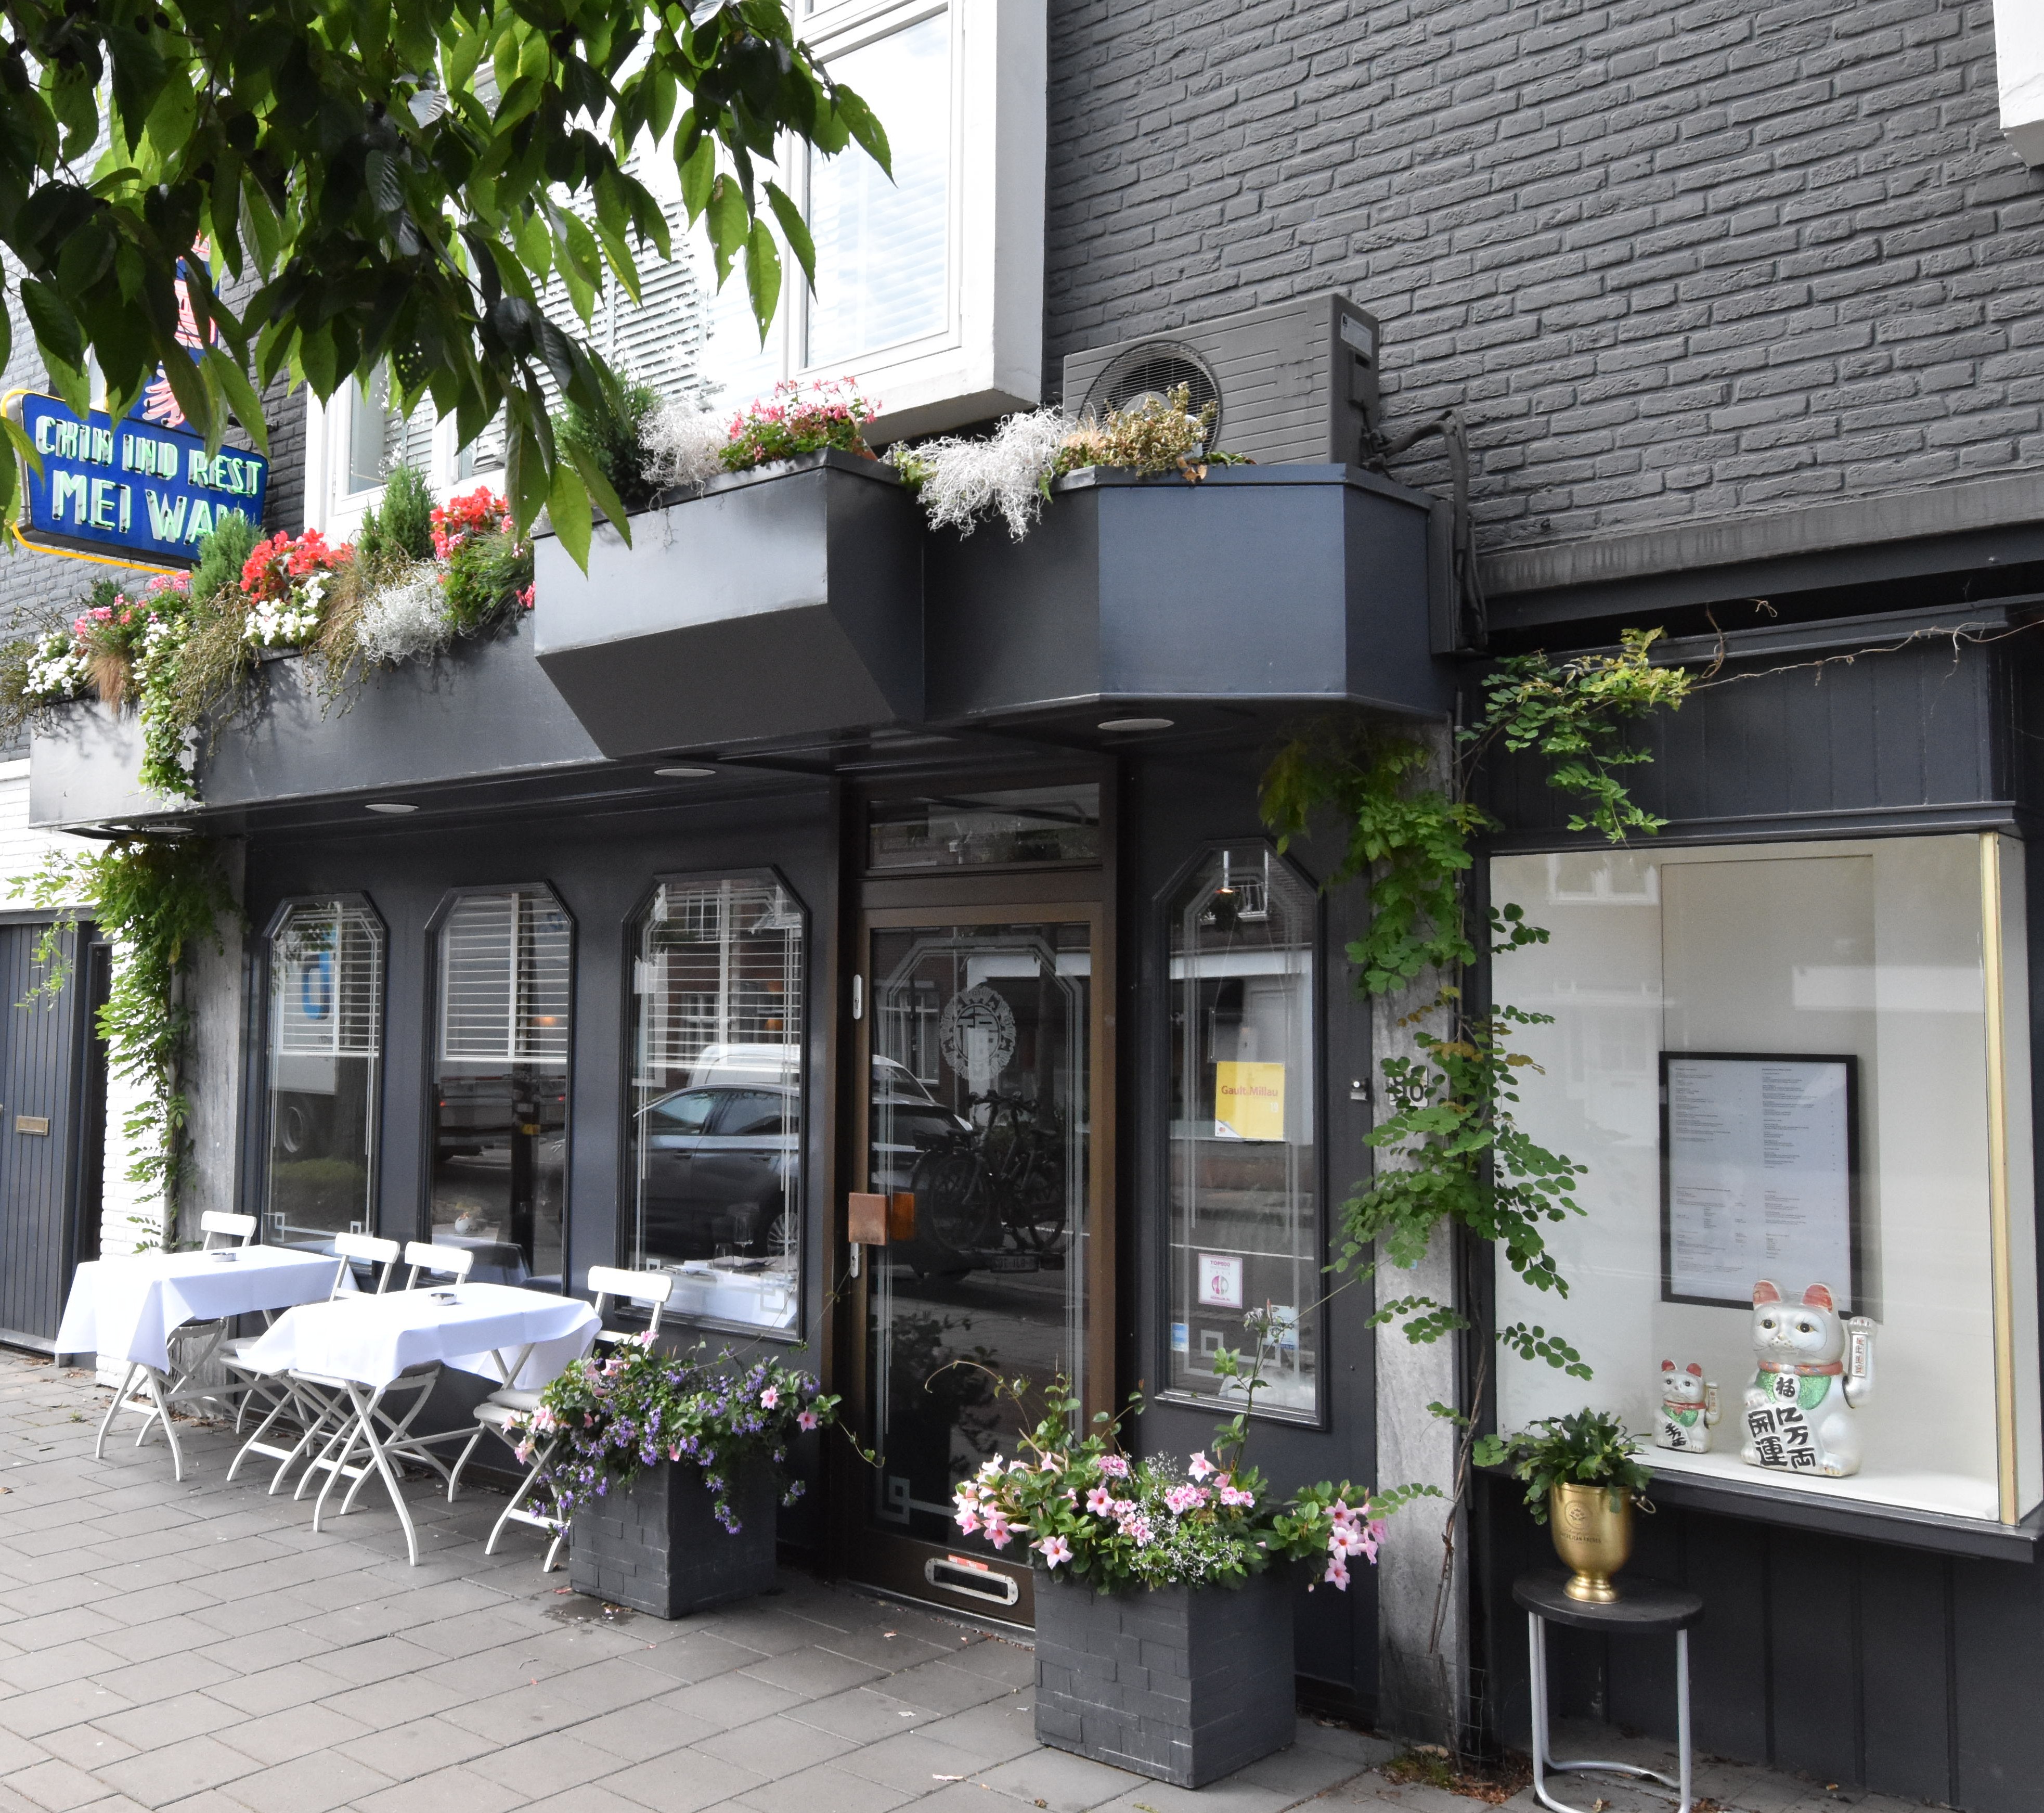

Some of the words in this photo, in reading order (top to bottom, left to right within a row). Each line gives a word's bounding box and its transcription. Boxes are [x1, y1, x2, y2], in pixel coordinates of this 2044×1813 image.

[122, 434, 178, 481] IND
[188, 449, 262, 498] REST
[53, 470, 131, 533] MEI
[1776, 1377, 1795, 1397] 福
[1748, 1409, 1788, 1467] 開運
